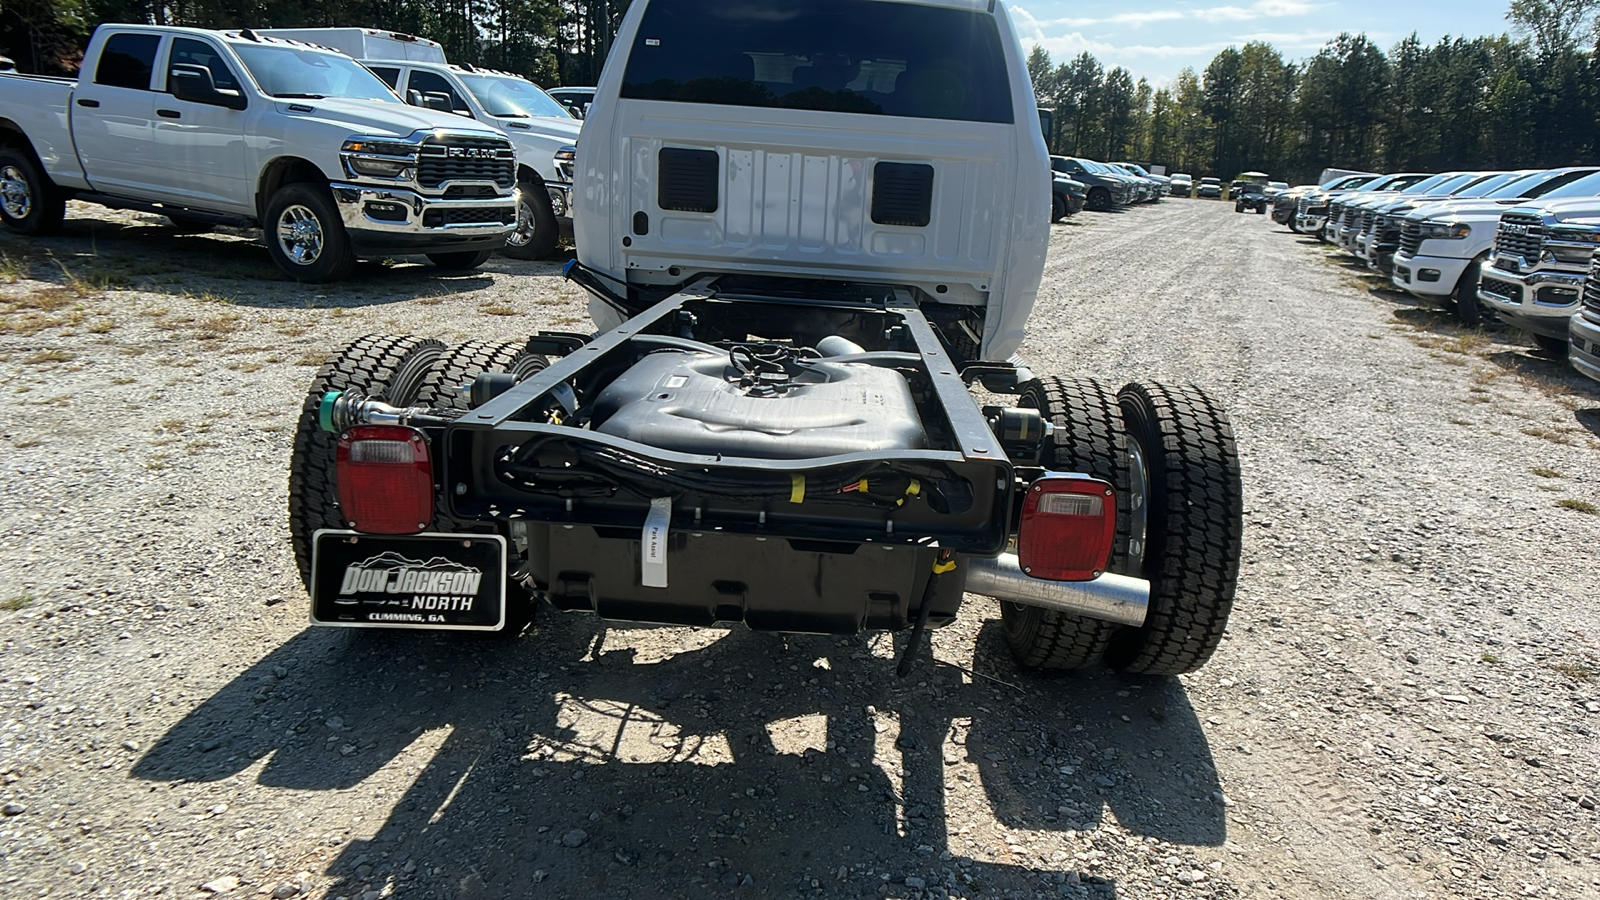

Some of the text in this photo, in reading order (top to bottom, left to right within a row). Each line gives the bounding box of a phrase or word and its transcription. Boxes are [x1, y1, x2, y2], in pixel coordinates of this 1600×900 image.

[448, 147, 496, 159] RAM
[339, 566, 483, 596] DON JACKSON
[411, 596, 474, 611] NORTH
[368, 613, 446, 623] CUMMING, GA
